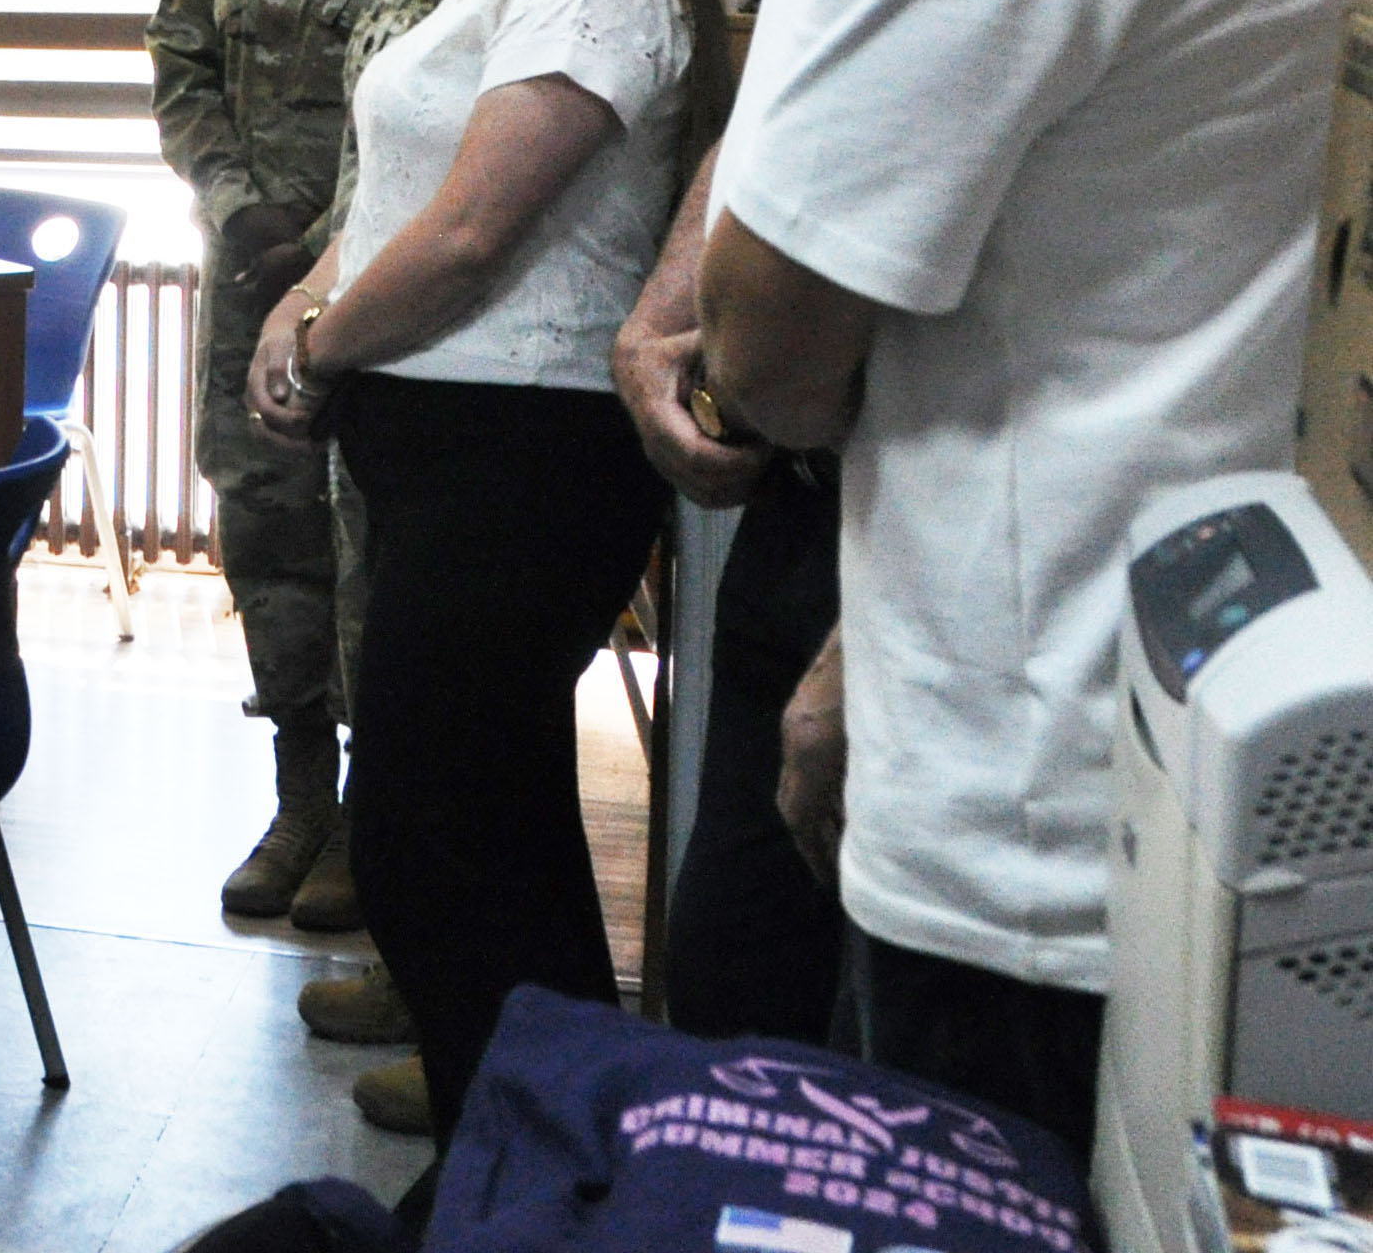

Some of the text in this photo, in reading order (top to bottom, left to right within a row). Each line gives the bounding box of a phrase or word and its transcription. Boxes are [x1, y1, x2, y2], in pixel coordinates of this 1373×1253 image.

[621, 1093, 878, 1156] CRIMINAL
[632, 1123, 1076, 1251] SUMMER SCHOO
